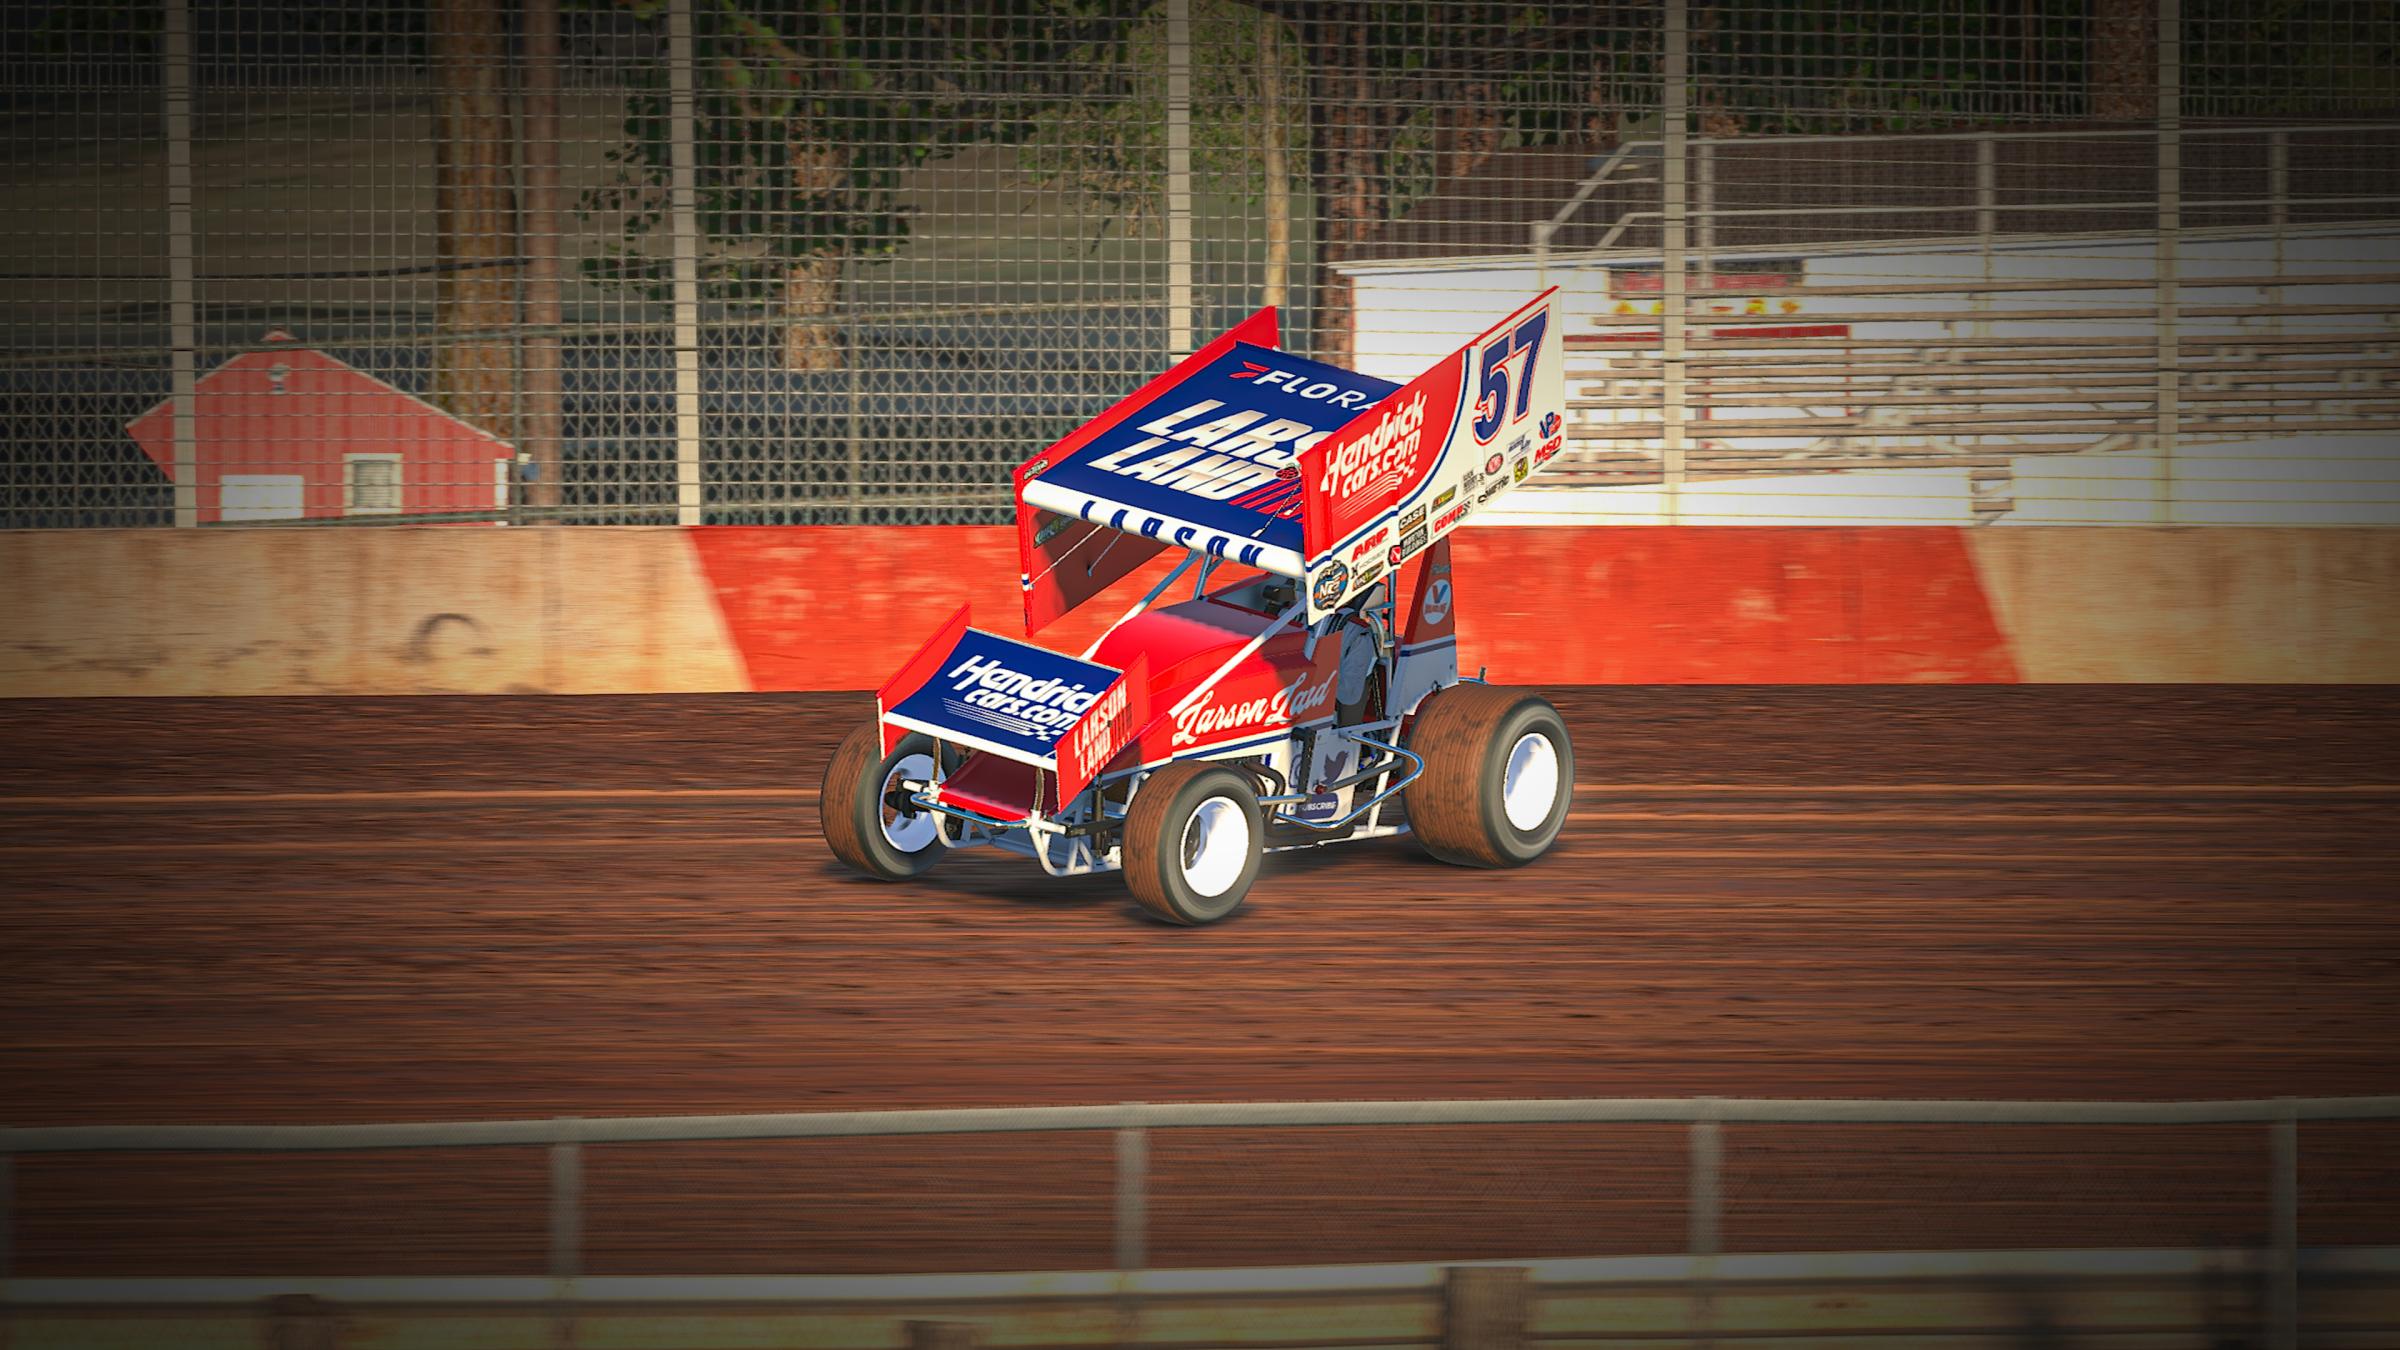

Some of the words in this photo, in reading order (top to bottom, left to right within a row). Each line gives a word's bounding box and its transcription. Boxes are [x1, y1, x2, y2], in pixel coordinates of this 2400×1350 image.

[1472, 303, 1550, 446] 57
[1086, 436, 1281, 501] LAND
[1320, 390, 1427, 497] Hendrick
[1342, 428, 1421, 498] cars.com
[1533, 435, 1562, 464] MSD
[1351, 527, 1389, 563] ARP
[1400, 506, 1426, 529] CASE
[1433, 503, 1465, 534] COMP
[964, 688, 1082, 730] cars.com
[1073, 680, 1127, 759] LARSON
[1172, 690, 1269, 747] Larson
[1264, 670, 1337, 726] Land
[1079, 727, 1111, 781] LAND
